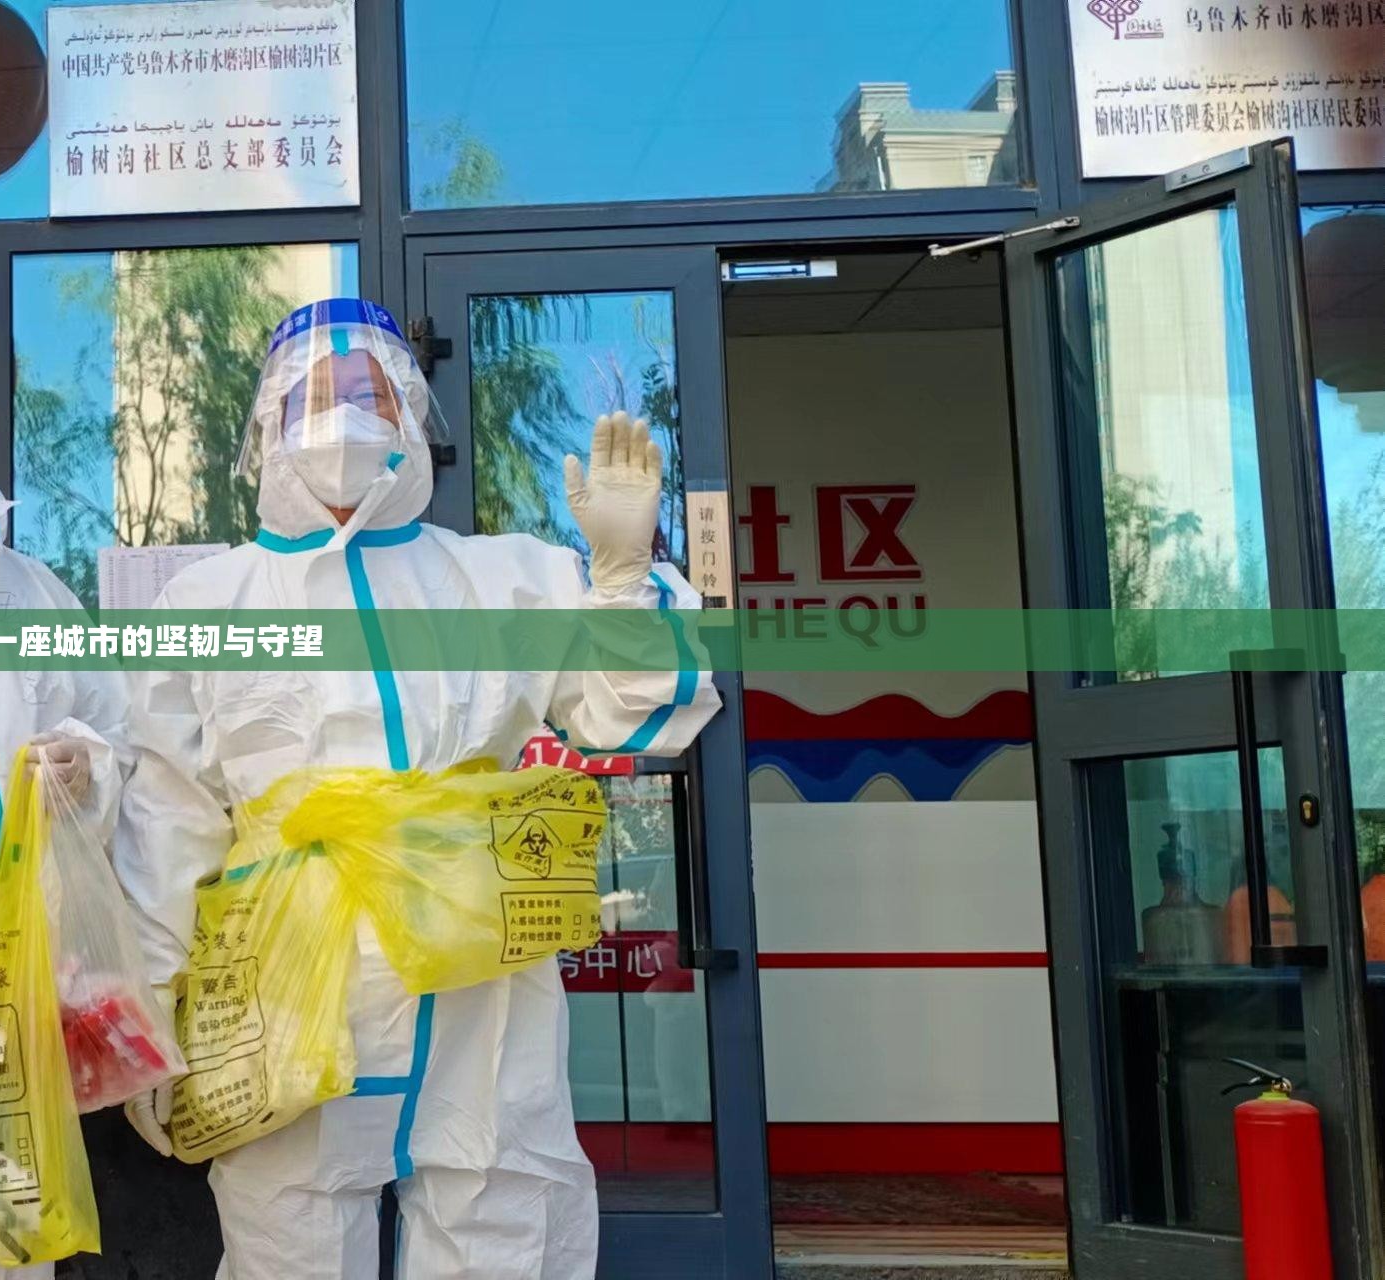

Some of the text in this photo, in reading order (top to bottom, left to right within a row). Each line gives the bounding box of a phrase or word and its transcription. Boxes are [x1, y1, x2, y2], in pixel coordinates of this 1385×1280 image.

[62, 42, 342, 79] 中国共产党乌鲁木齐市水磨沟区榆树沟片区
[1095, 96, 1385, 136] 榆树沟片区管理委员会榆树沟社区居民委员
[66, 134, 343, 176] 榆树沟社区总支部委员会
[698, 506, 717, 588] 请按门铃
